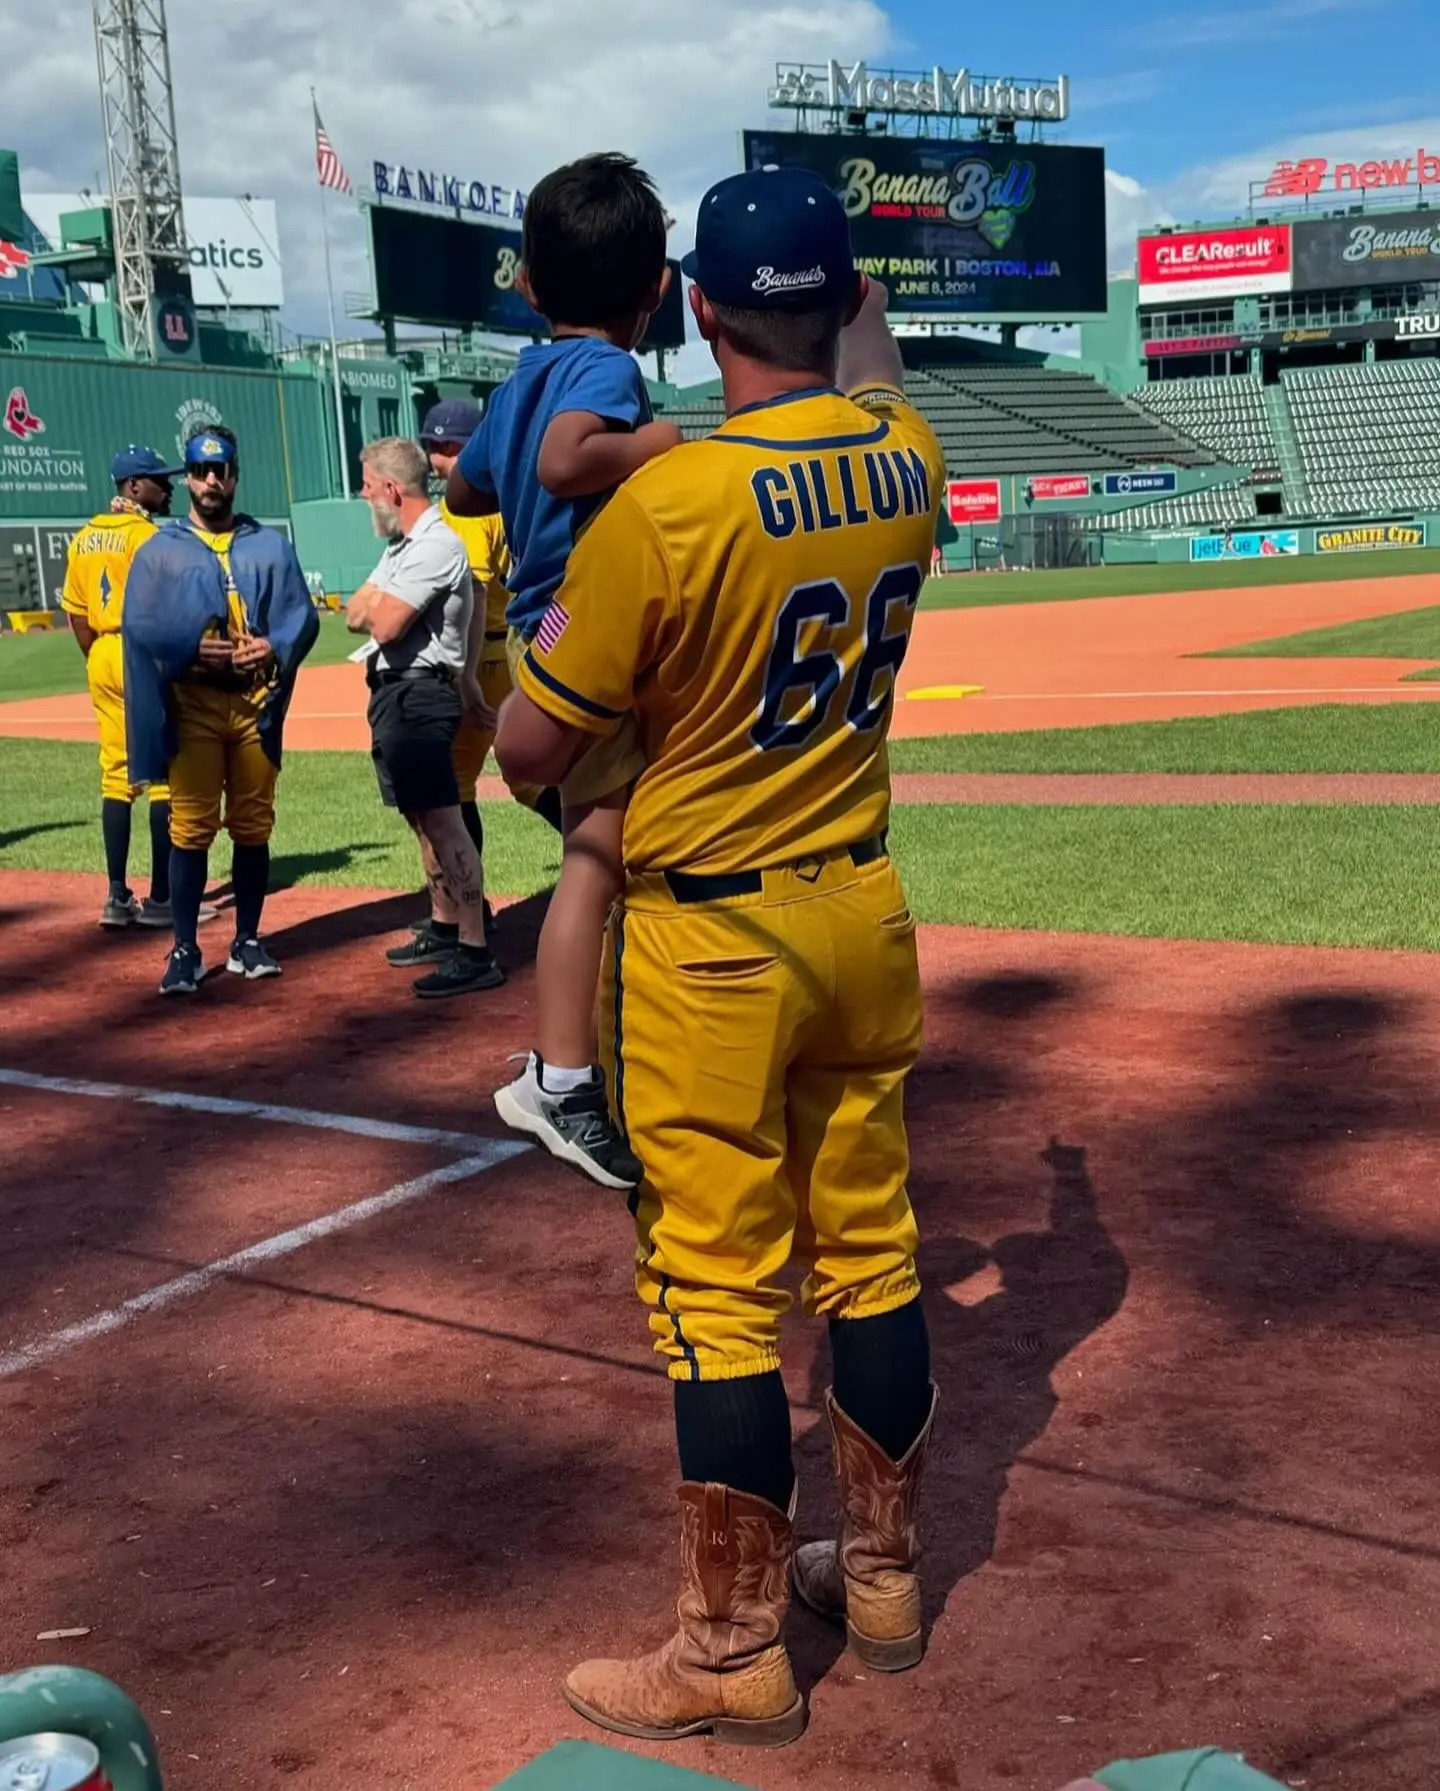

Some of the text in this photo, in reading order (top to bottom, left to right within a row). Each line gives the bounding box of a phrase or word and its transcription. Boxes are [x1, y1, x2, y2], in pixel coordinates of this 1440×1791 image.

[828, 58, 1069, 121] MassMutual
[373, 160, 461, 208] BANK
[469, 181, 502, 214] OF
[841, 158, 1034, 222] Banana Ball
[1335, 159, 1412, 191] new
[871, 204, 946, 218] WORLD TOUR
[190, 238, 264, 268] atics
[1342, 225, 1432, 262] Banana
[752, 264, 826, 296] Bananas
[889, 258, 938, 276] PARK
[955, 260, 1033, 279] BOSTON,
[896, 281, 930, 294] JUNE
[945, 281, 976, 294] 2024
[1394, 315, 1440, 334] TRU
[341, 371, 397, 389] ABIOMED
[4, 445, 50, 457] RED SOX
[750, 447, 931, 539] GILLUM
[1319, 528, 1385, 550] GRANITE
[1388, 526, 1423, 543] CITY
[747, 561, 923, 752] 66
